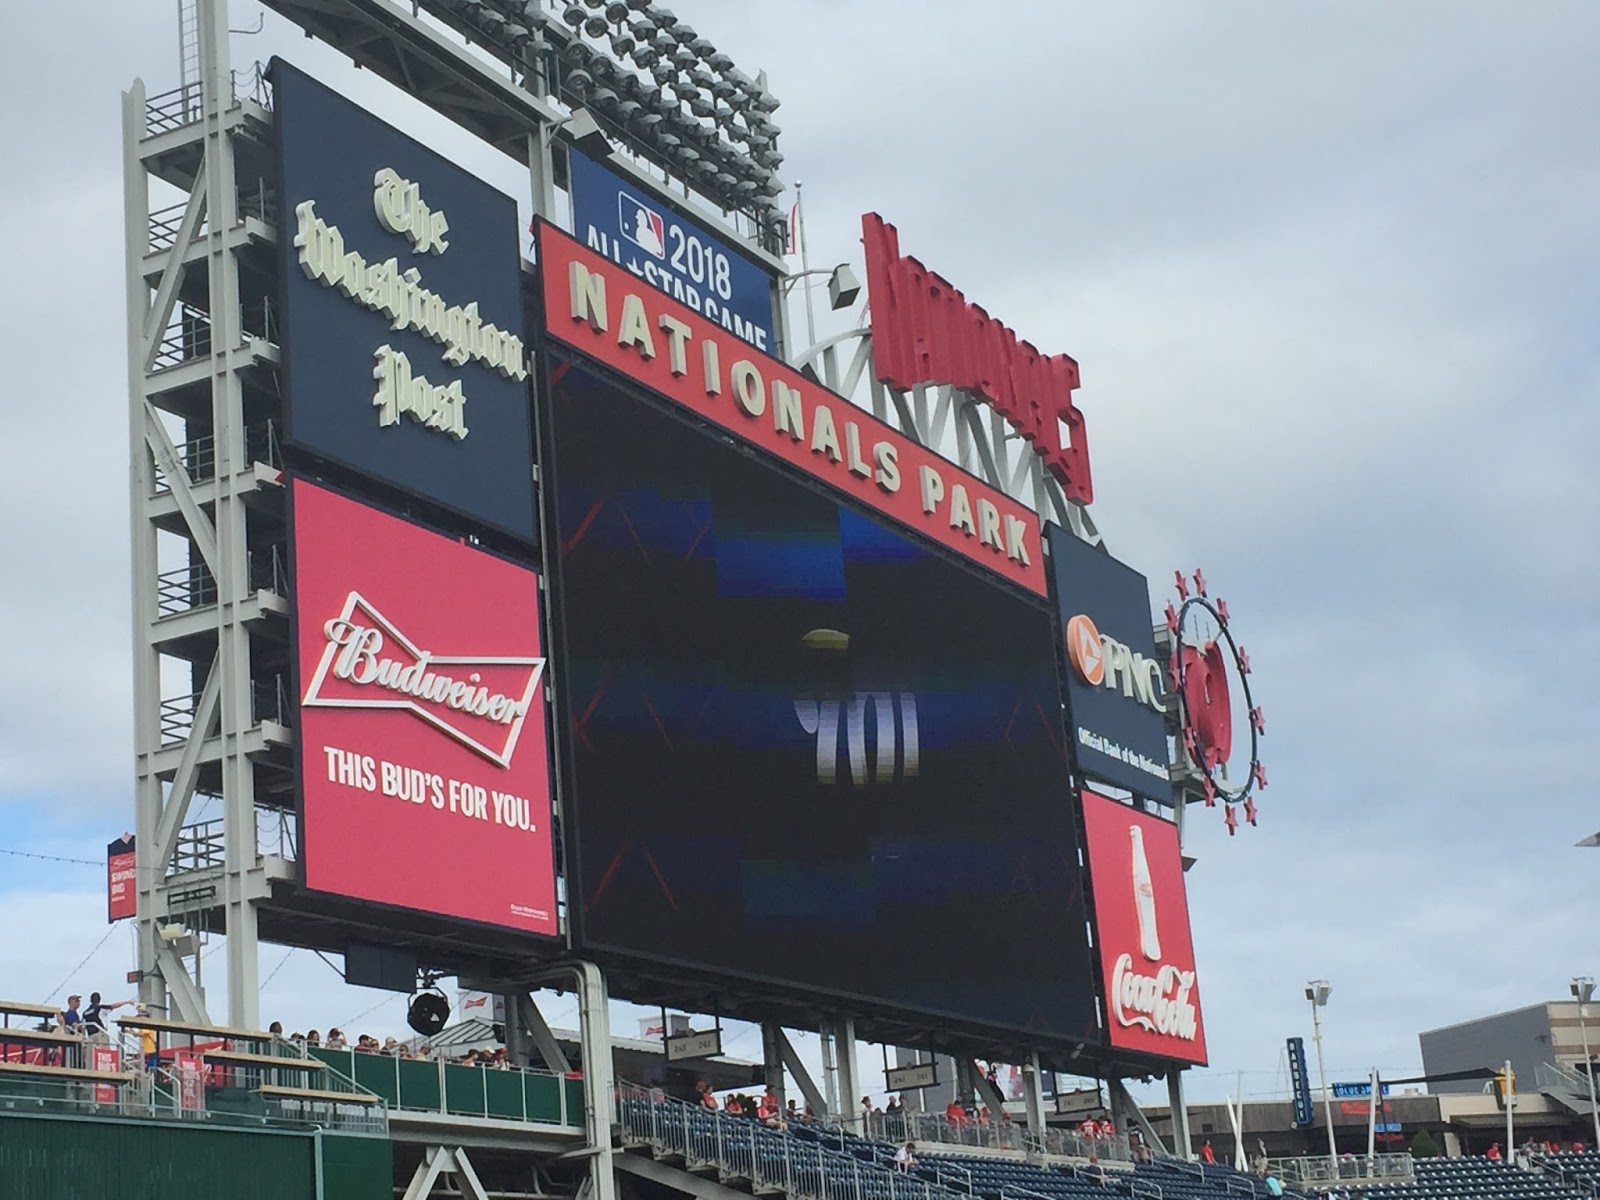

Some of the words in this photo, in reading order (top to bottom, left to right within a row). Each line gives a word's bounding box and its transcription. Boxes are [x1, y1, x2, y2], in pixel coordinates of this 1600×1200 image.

[374, 167, 449, 256] The
[294, 200, 528, 382] Washington
[669, 224, 732, 300] 2018
[373, 344, 469, 440] Post
[569, 261, 901, 492] NATIONALS
[920, 465, 1031, 566] PARK
[324, 618, 524, 724] Budweiser
[1100, 633, 1167, 713] PNC
[323, 745, 376, 793] THIS
[381, 760, 444, 810] BUD'S
[449, 778, 488, 821] FOR
[491, 790, 537, 833] YOU.
[1289, 1042, 1304, 1119] BARBECUE
